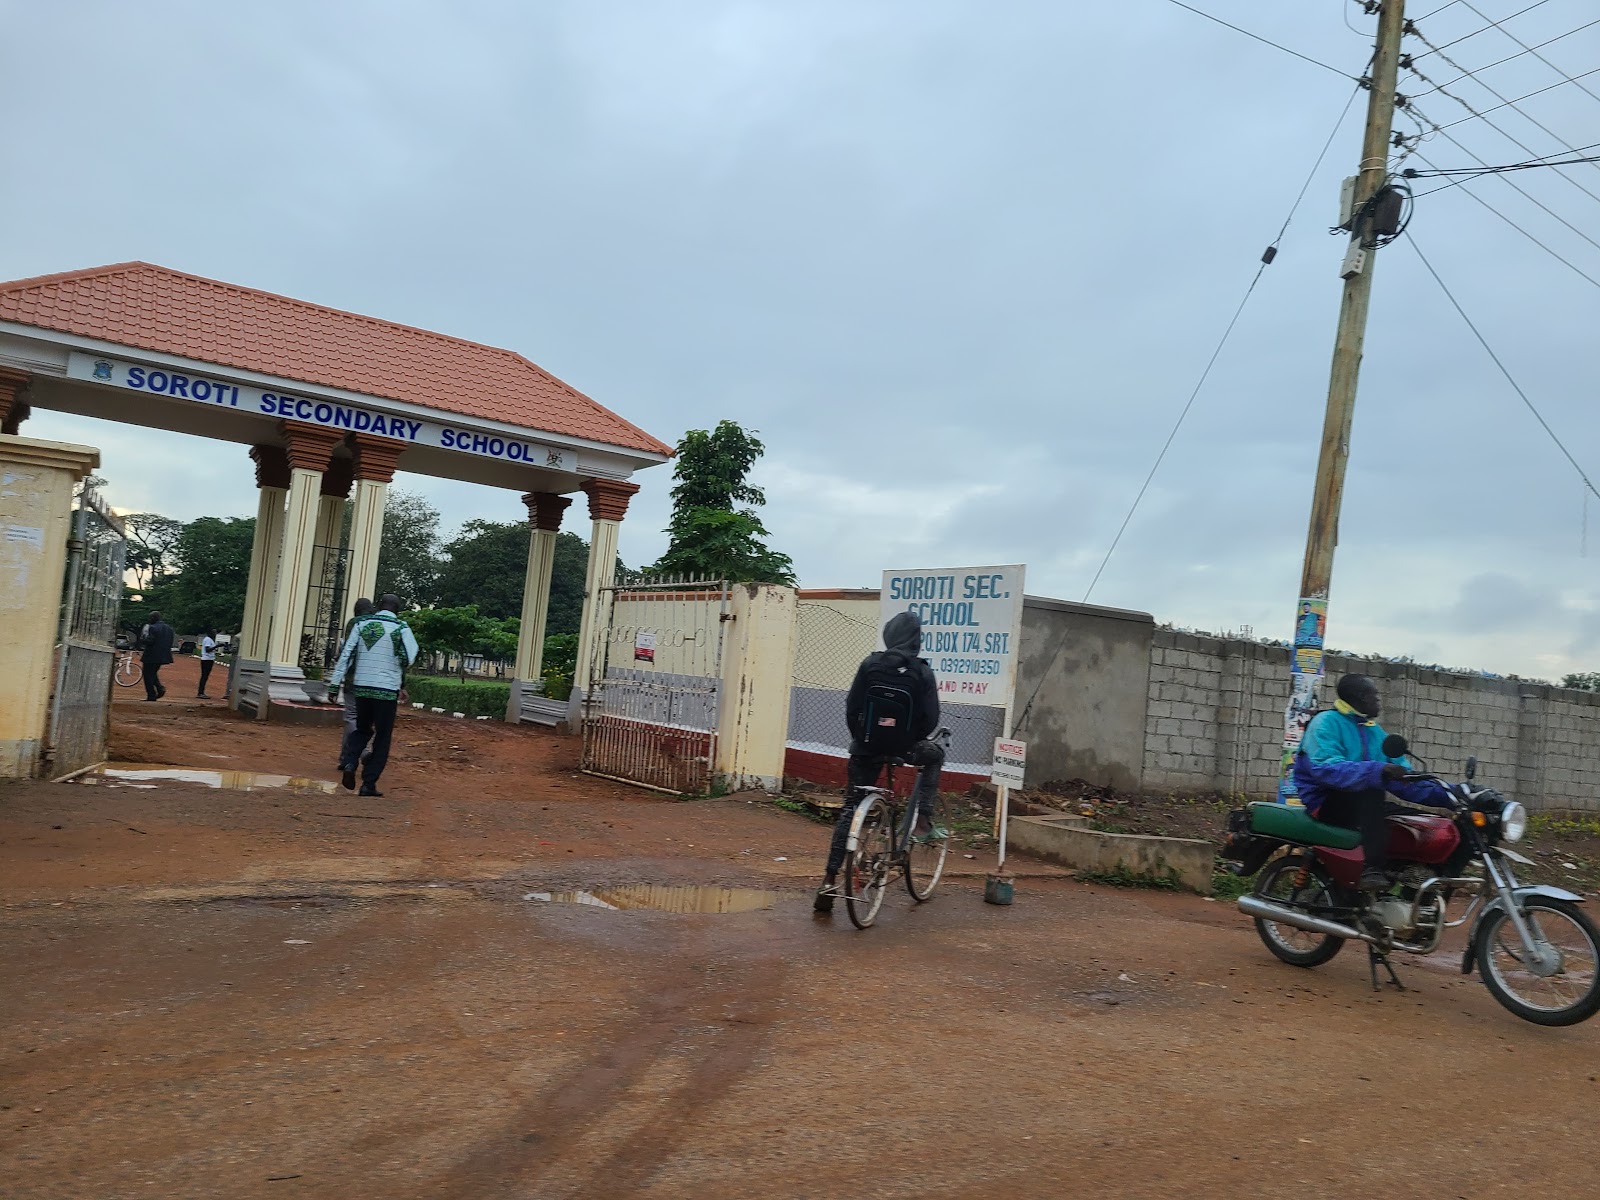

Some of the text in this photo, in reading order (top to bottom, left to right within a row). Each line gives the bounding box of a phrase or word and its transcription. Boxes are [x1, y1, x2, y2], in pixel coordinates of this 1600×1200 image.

[127, 367, 534, 463] SOROTI SECONDARY SCHOOL
[890, 575, 1009, 600] SOROTI SEC.
[937, 680, 989, 694] AND PRAY
